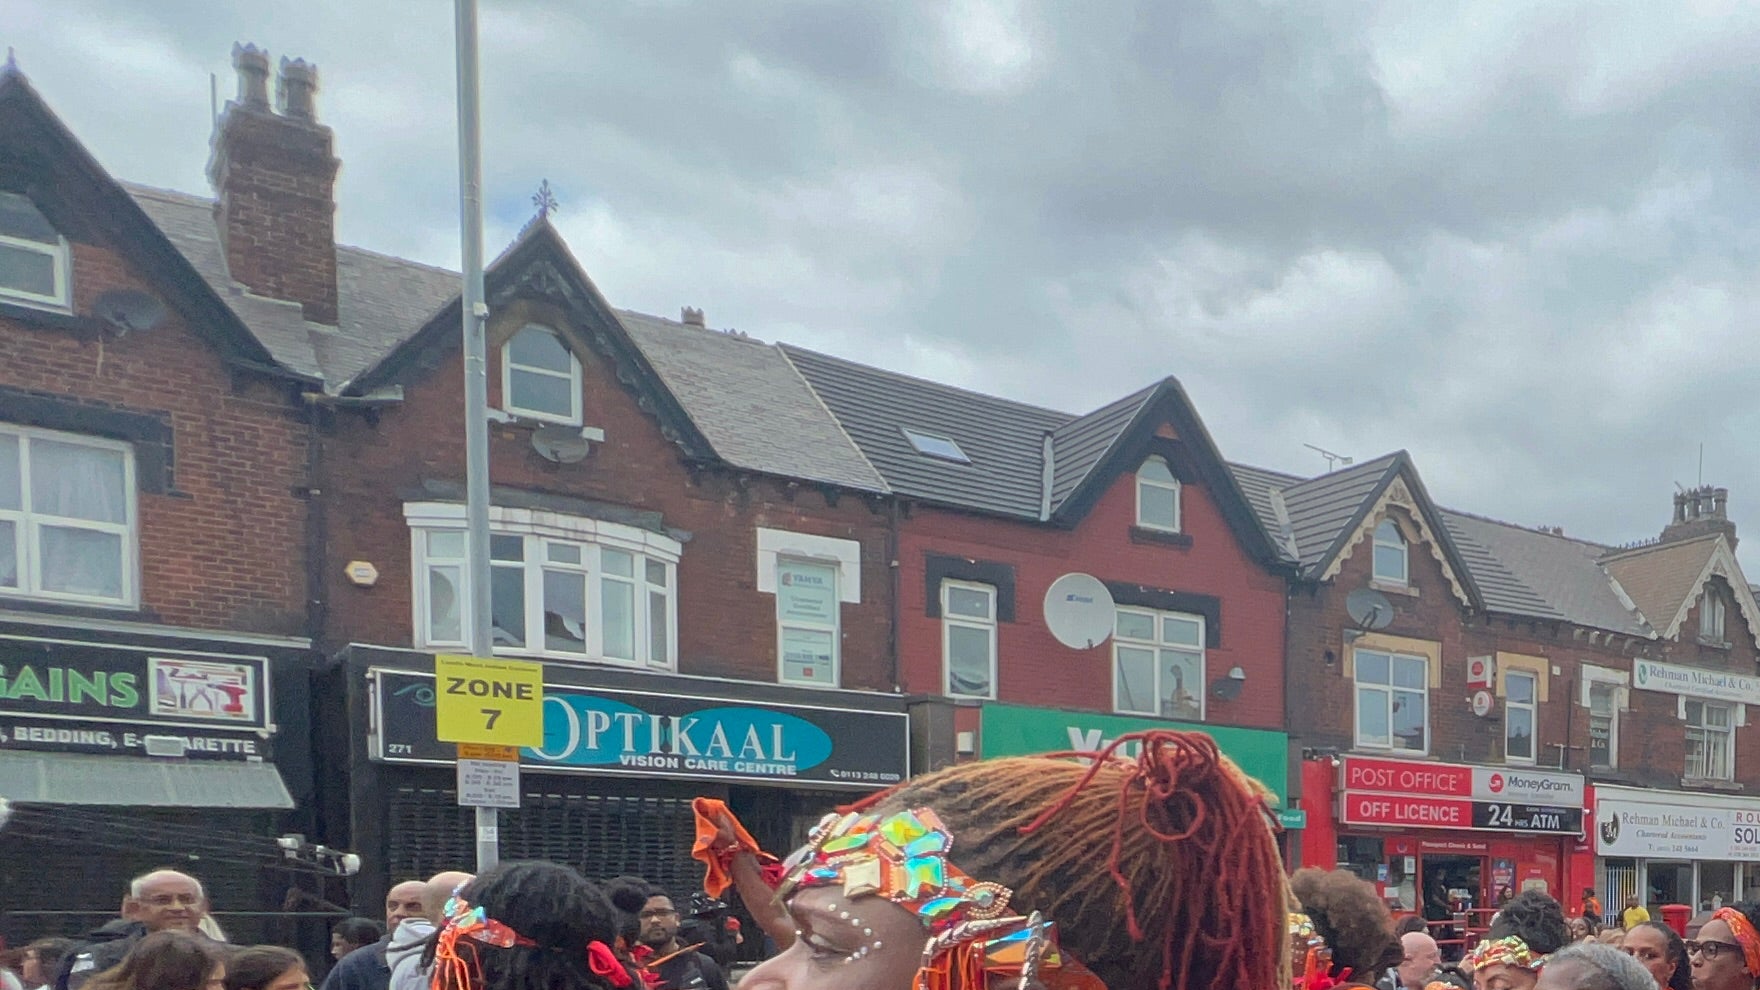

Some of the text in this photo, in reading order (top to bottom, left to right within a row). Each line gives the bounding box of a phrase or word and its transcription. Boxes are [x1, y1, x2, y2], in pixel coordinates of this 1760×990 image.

[446, 677, 534, 700] ZONE
[1649, 665, 1689, 682] Rehman
[1728, 680, 1736, 689] &
[481, 709, 502, 730] 7
[530, 697, 796, 761] OPTIKAAL
[14, 726, 117, 749] BEDDING,
[388, 743, 412, 754] 271
[619, 754, 797, 776] VISION CARE CENTRE
[1352, 767, 1457, 791] POST OFFICE
[1360, 801, 1459, 822] OFF LICENCE
[1488, 804, 1513, 827] 24
[1530, 814, 1560, 829] ATM
[1622, 811, 1659, 826] Rehman
[1662, 814, 1698, 828] Michael
[1700, 818, 1707, 829] &
